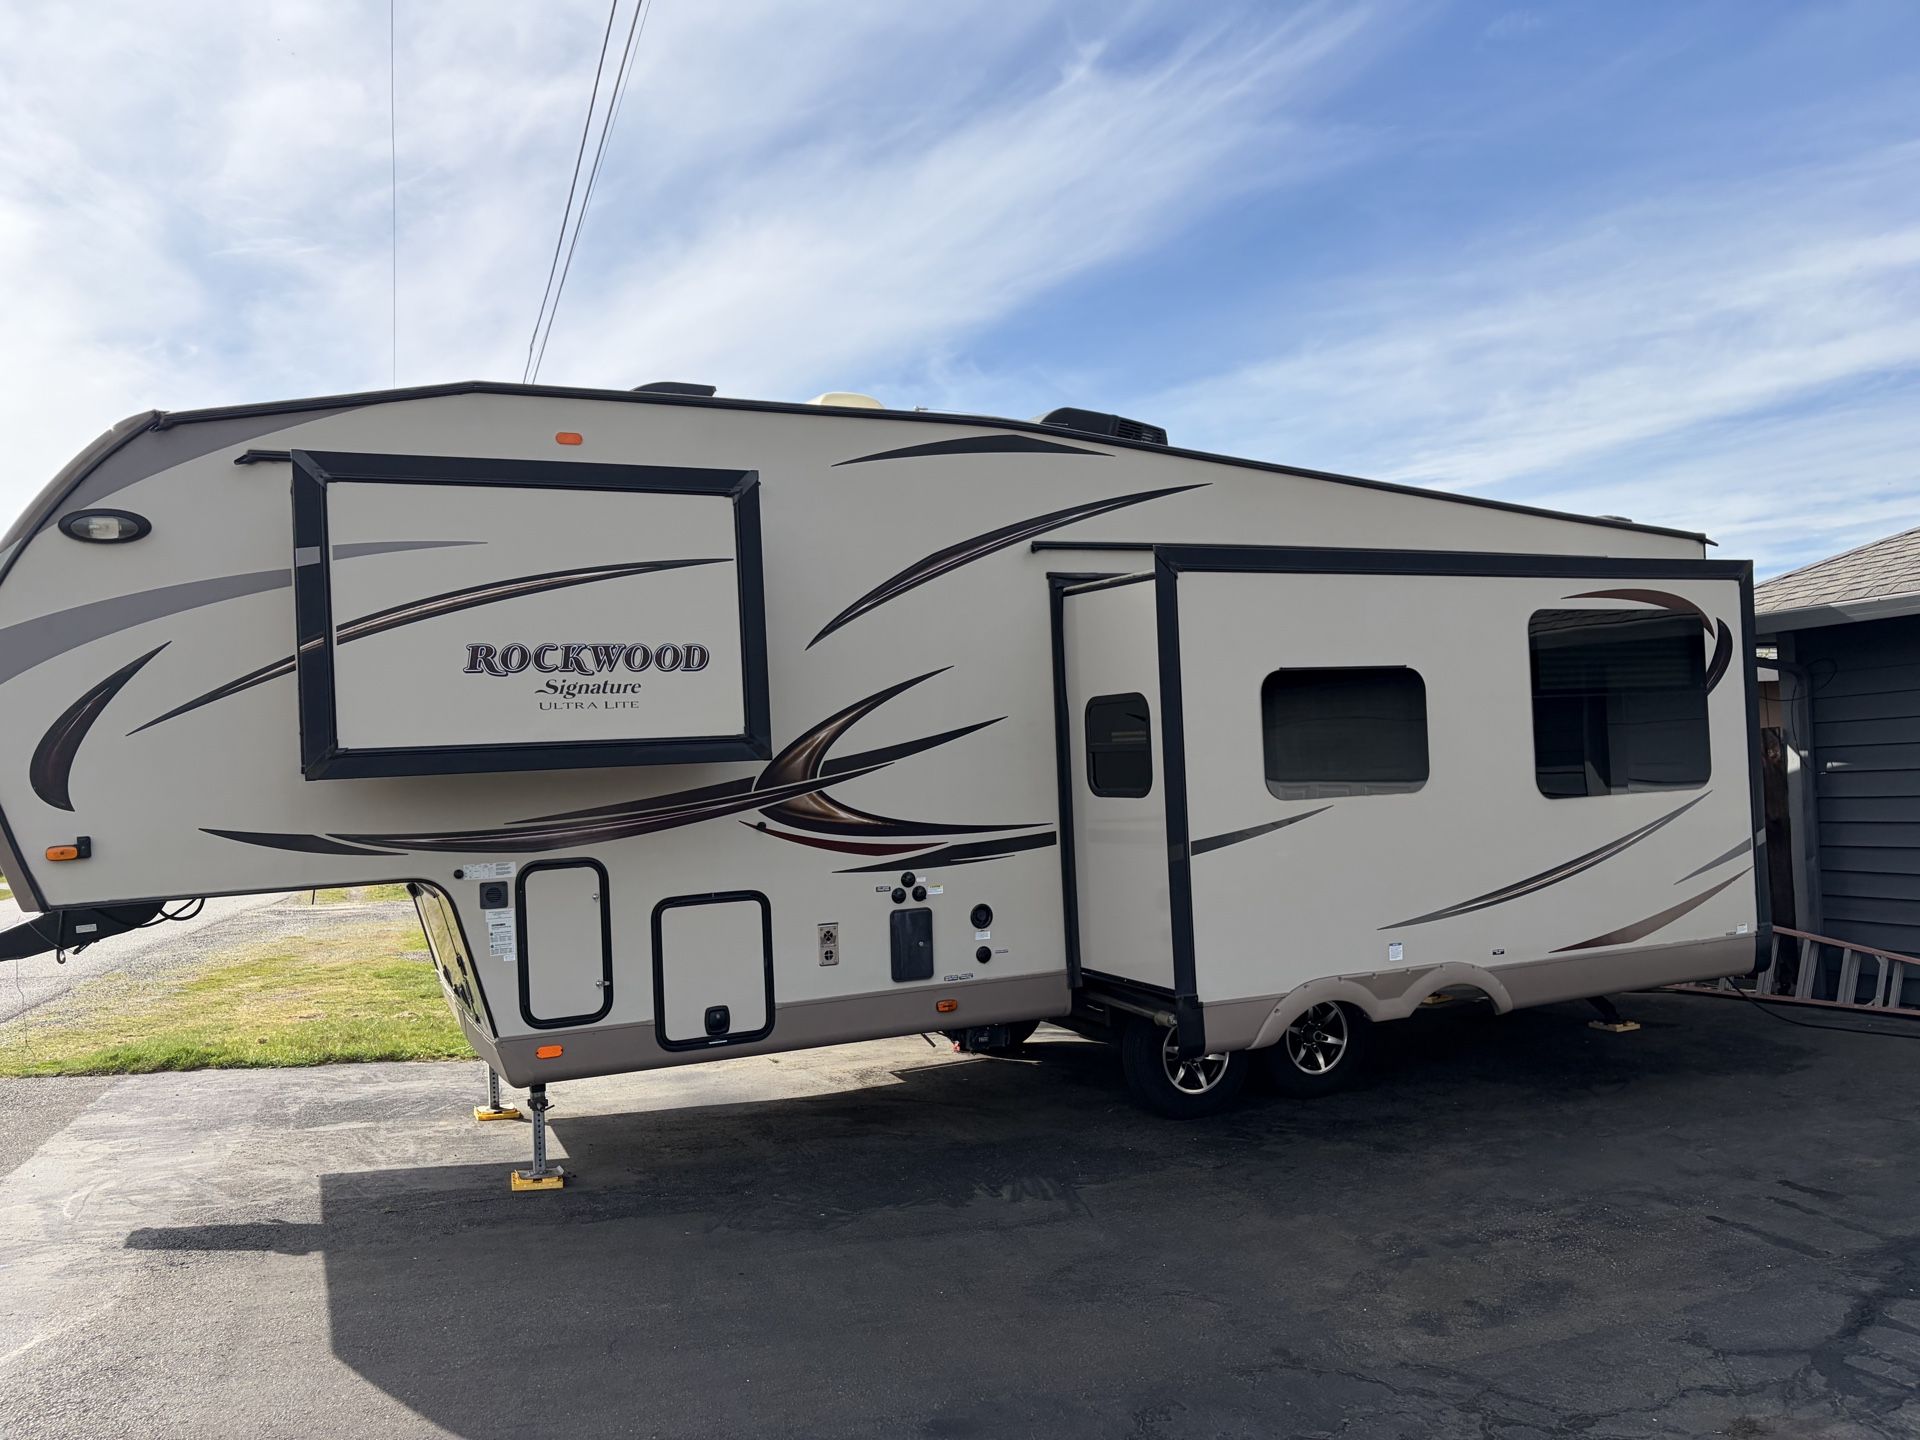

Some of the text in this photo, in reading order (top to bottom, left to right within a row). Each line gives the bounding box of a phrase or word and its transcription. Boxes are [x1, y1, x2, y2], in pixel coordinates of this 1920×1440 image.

[463, 643, 710, 676] ROCKWOOD
[535, 679, 642, 699] Signature
[539, 700, 639, 711] ULTRA LITE
